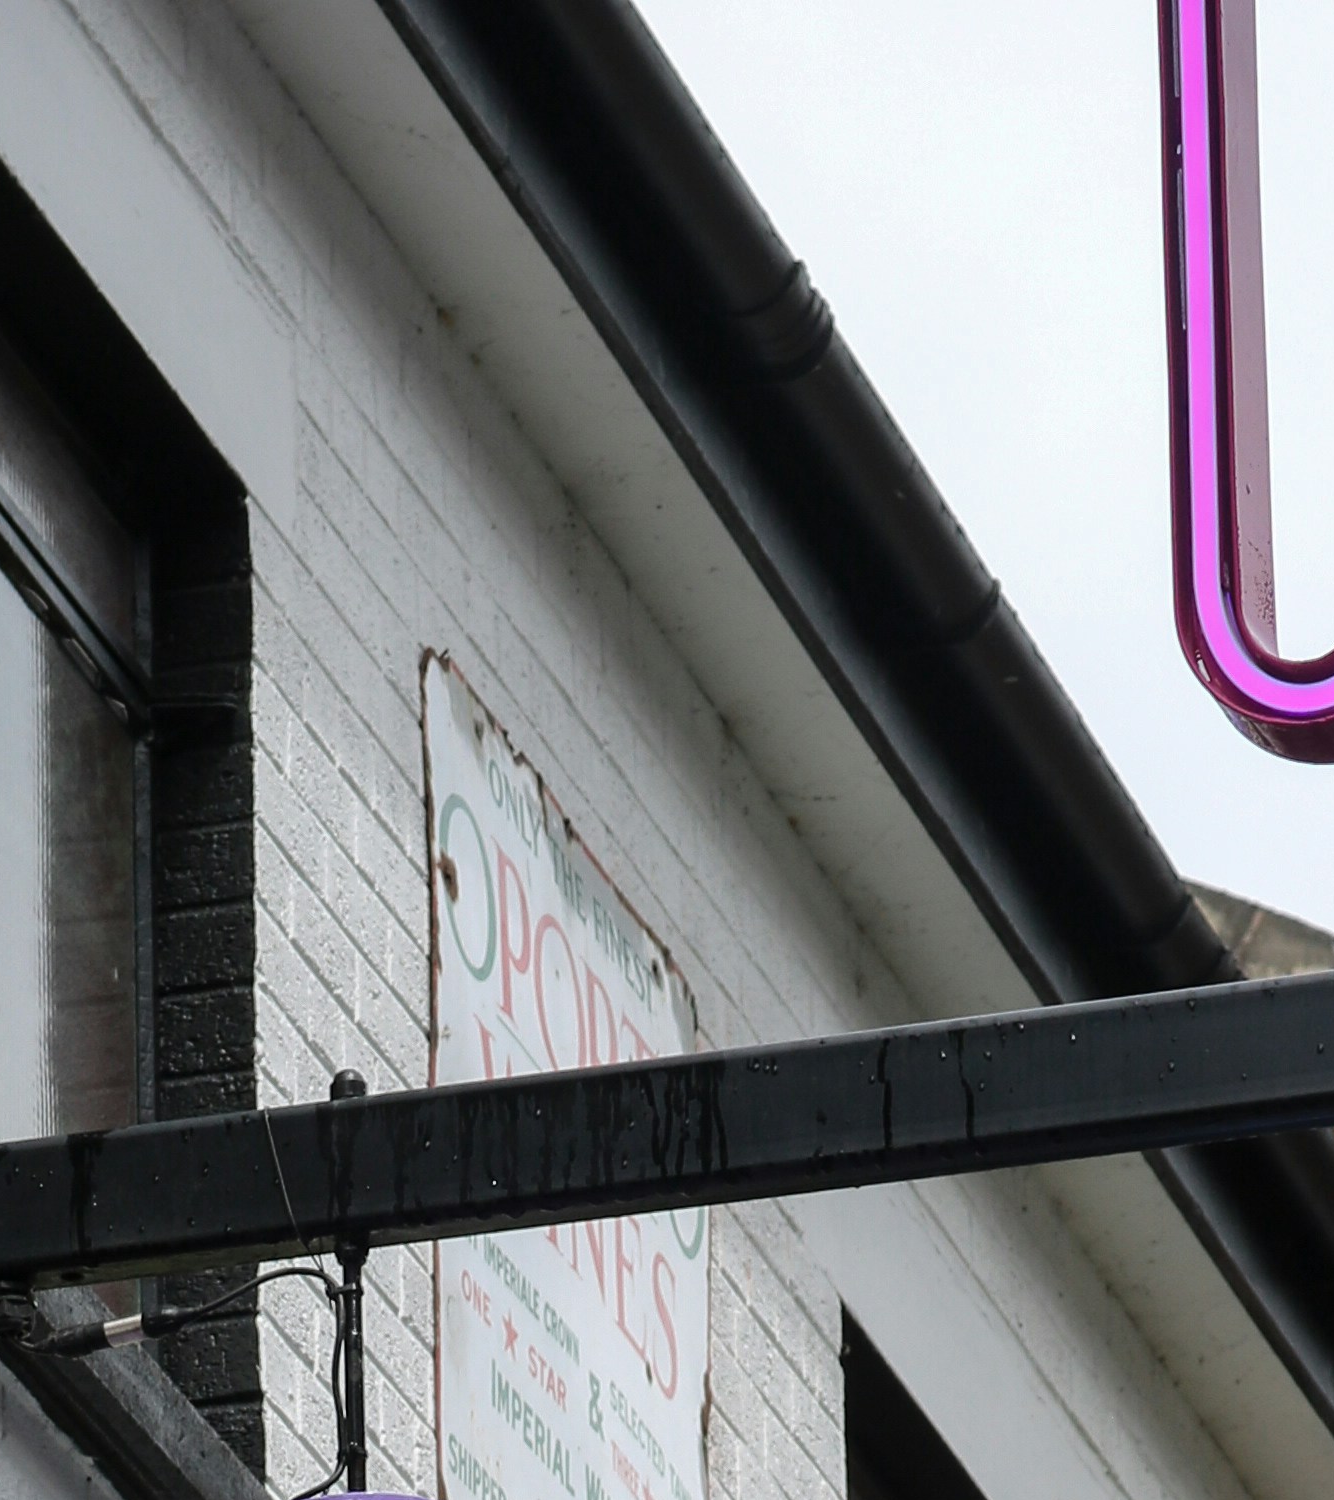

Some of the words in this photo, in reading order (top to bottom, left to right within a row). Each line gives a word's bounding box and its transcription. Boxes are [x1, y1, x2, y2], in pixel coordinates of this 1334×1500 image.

[487, 758, 543, 858] ONLY
[548, 834, 588, 926] THE
[592, 896, 657, 1013] FINEST
[461, 1268, 492, 1328] ONE
[527, 1345, 568, 1413] STAR
[489, 1358, 576, 1497] IMPERIAL
[609, 1379, 666, 1478] SELECTED
